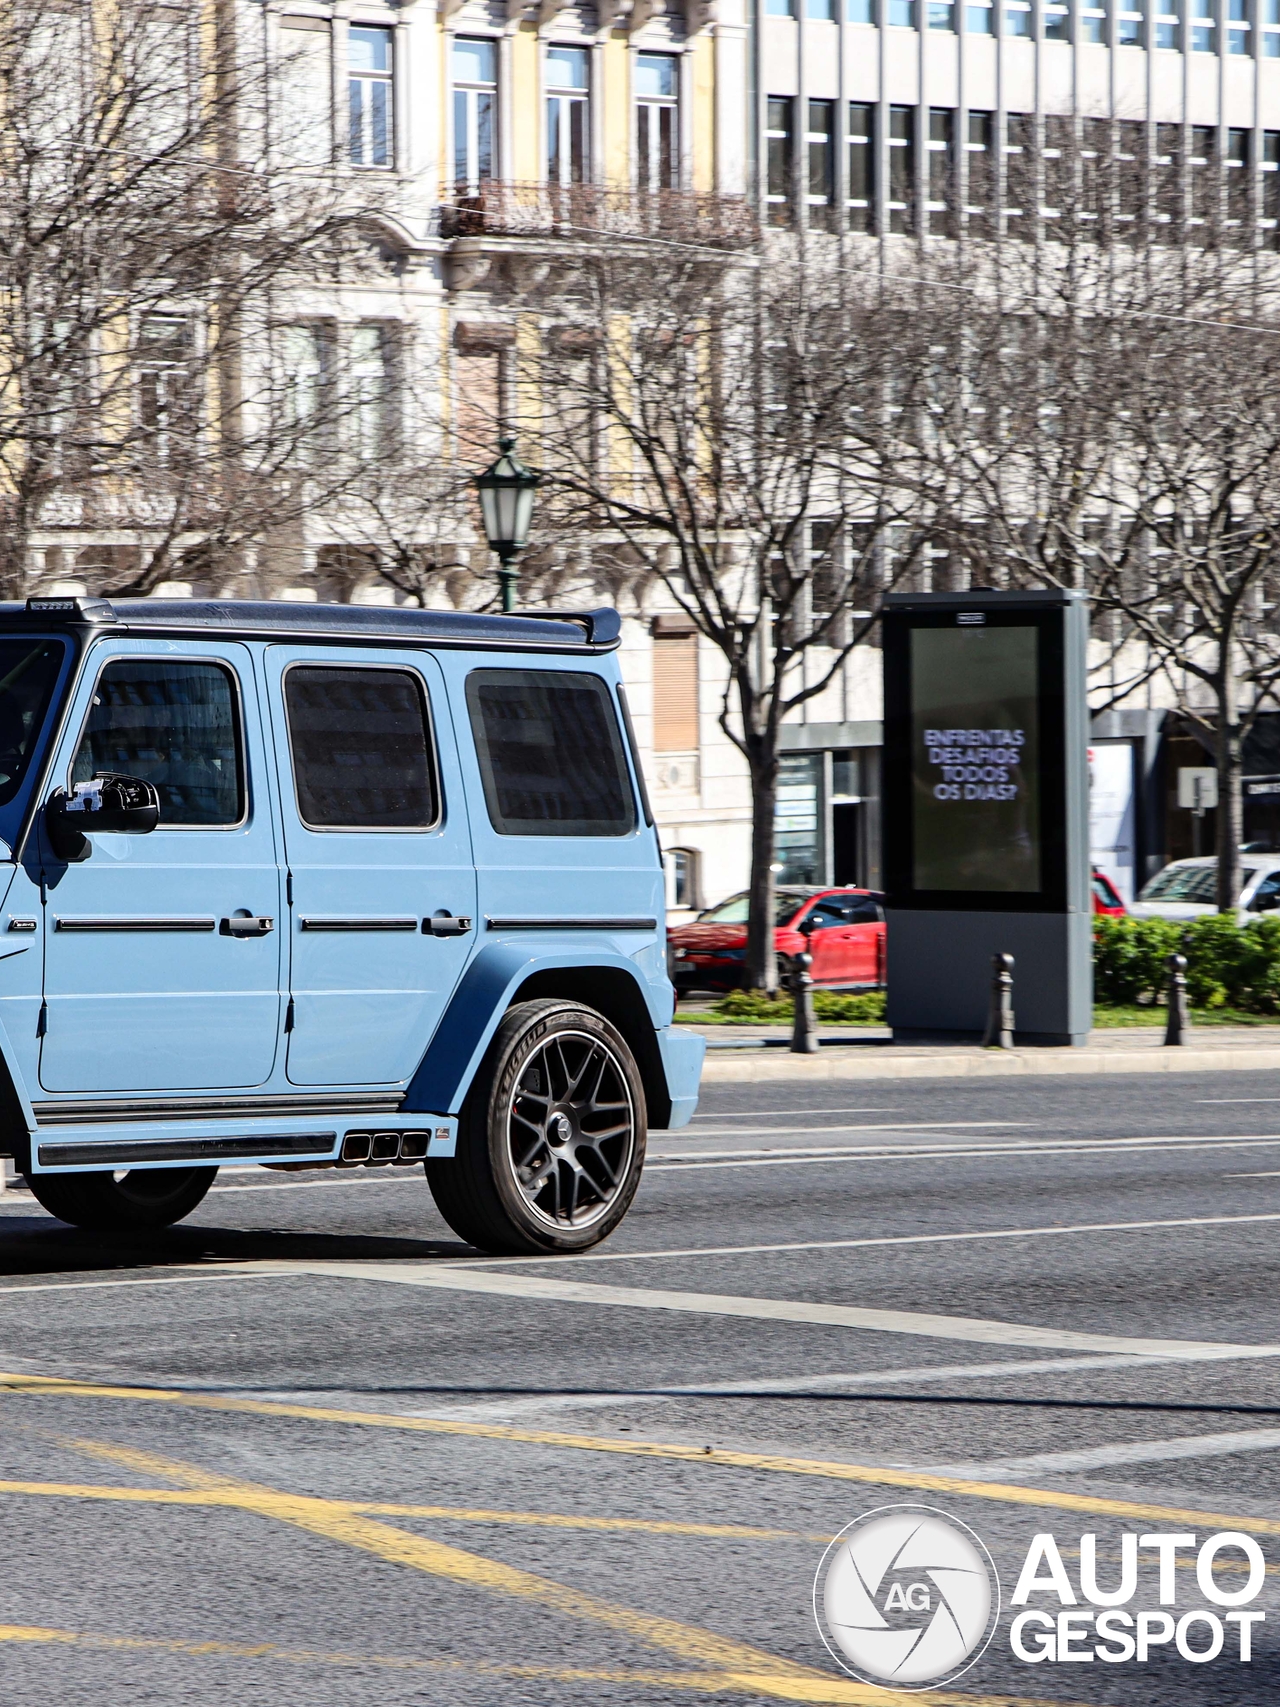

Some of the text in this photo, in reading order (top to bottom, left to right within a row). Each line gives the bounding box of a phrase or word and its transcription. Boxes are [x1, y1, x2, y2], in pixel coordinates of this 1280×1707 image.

[923, 729, 1025, 746] ENFRENTAS
[929, 747, 1020, 764] DESAFIOS
[940, 765, 1010, 782] TODOS
[933, 783, 1018, 801] OS DIAS?
